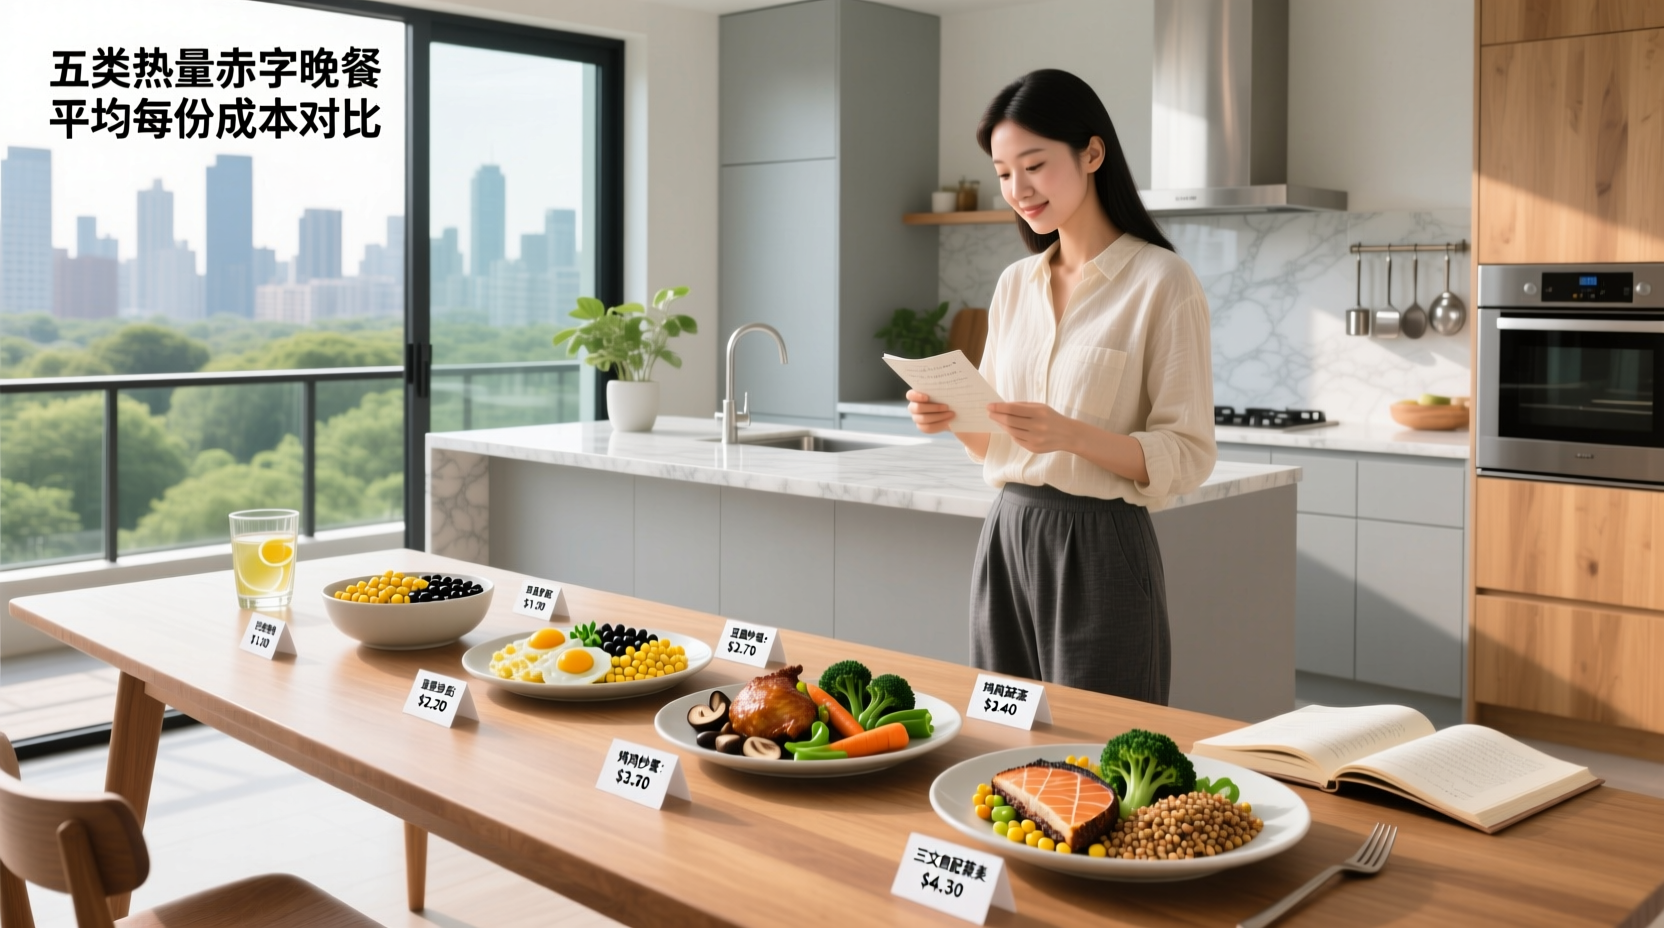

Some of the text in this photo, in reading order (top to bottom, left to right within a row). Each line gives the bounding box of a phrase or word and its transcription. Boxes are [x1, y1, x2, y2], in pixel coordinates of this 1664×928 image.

[727, 641, 757, 656] $2.70
[615, 769, 650, 790] $3.70
[921, 872, 964, 898] $4.30
